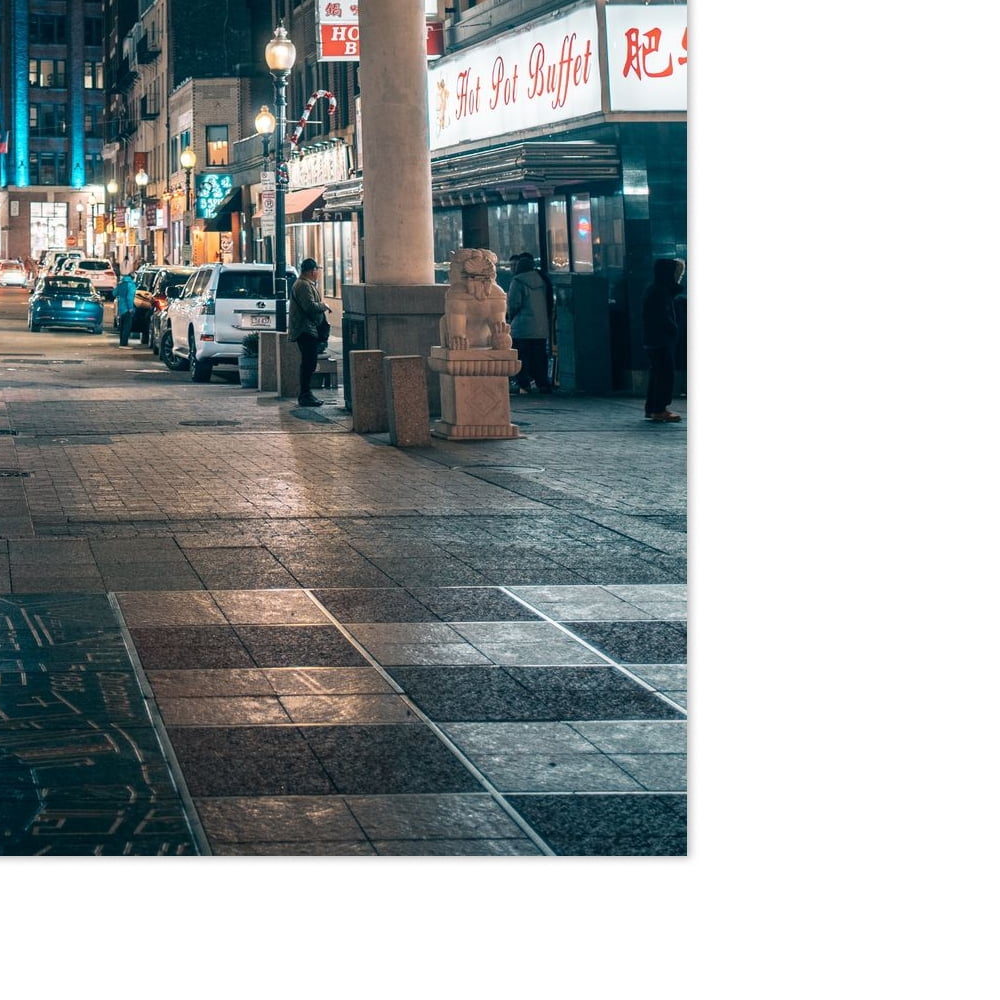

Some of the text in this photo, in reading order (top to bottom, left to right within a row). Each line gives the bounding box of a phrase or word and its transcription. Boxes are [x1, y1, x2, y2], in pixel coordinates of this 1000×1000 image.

[456, 31, 592, 121] Hot Pot Buffet
